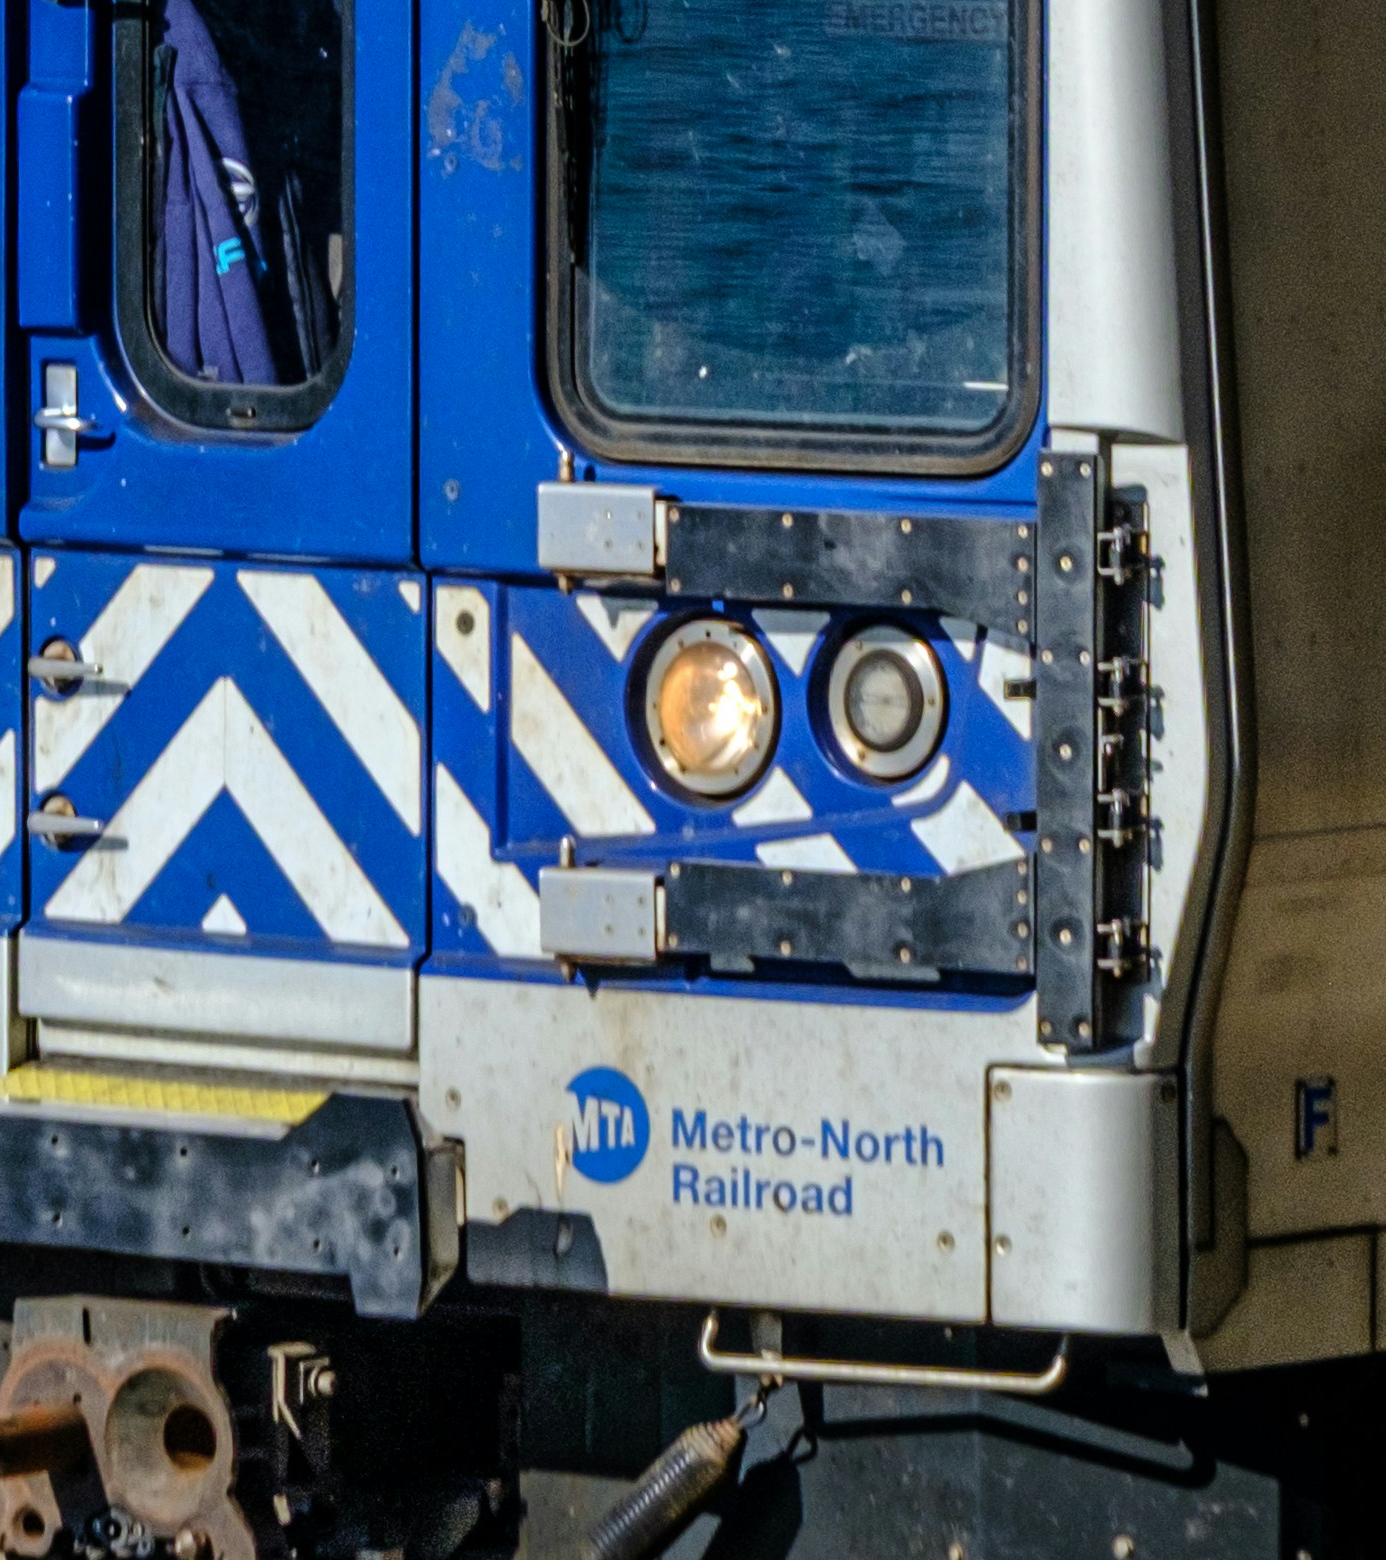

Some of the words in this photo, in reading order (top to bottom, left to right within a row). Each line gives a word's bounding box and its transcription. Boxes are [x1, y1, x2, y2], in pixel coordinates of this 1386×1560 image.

[566, 1090, 636, 1154] MTA
[670, 1107, 946, 1168] Metro-North
[1304, 1087, 1332, 1150] F
[671, 1160, 854, 1216] Railroad
